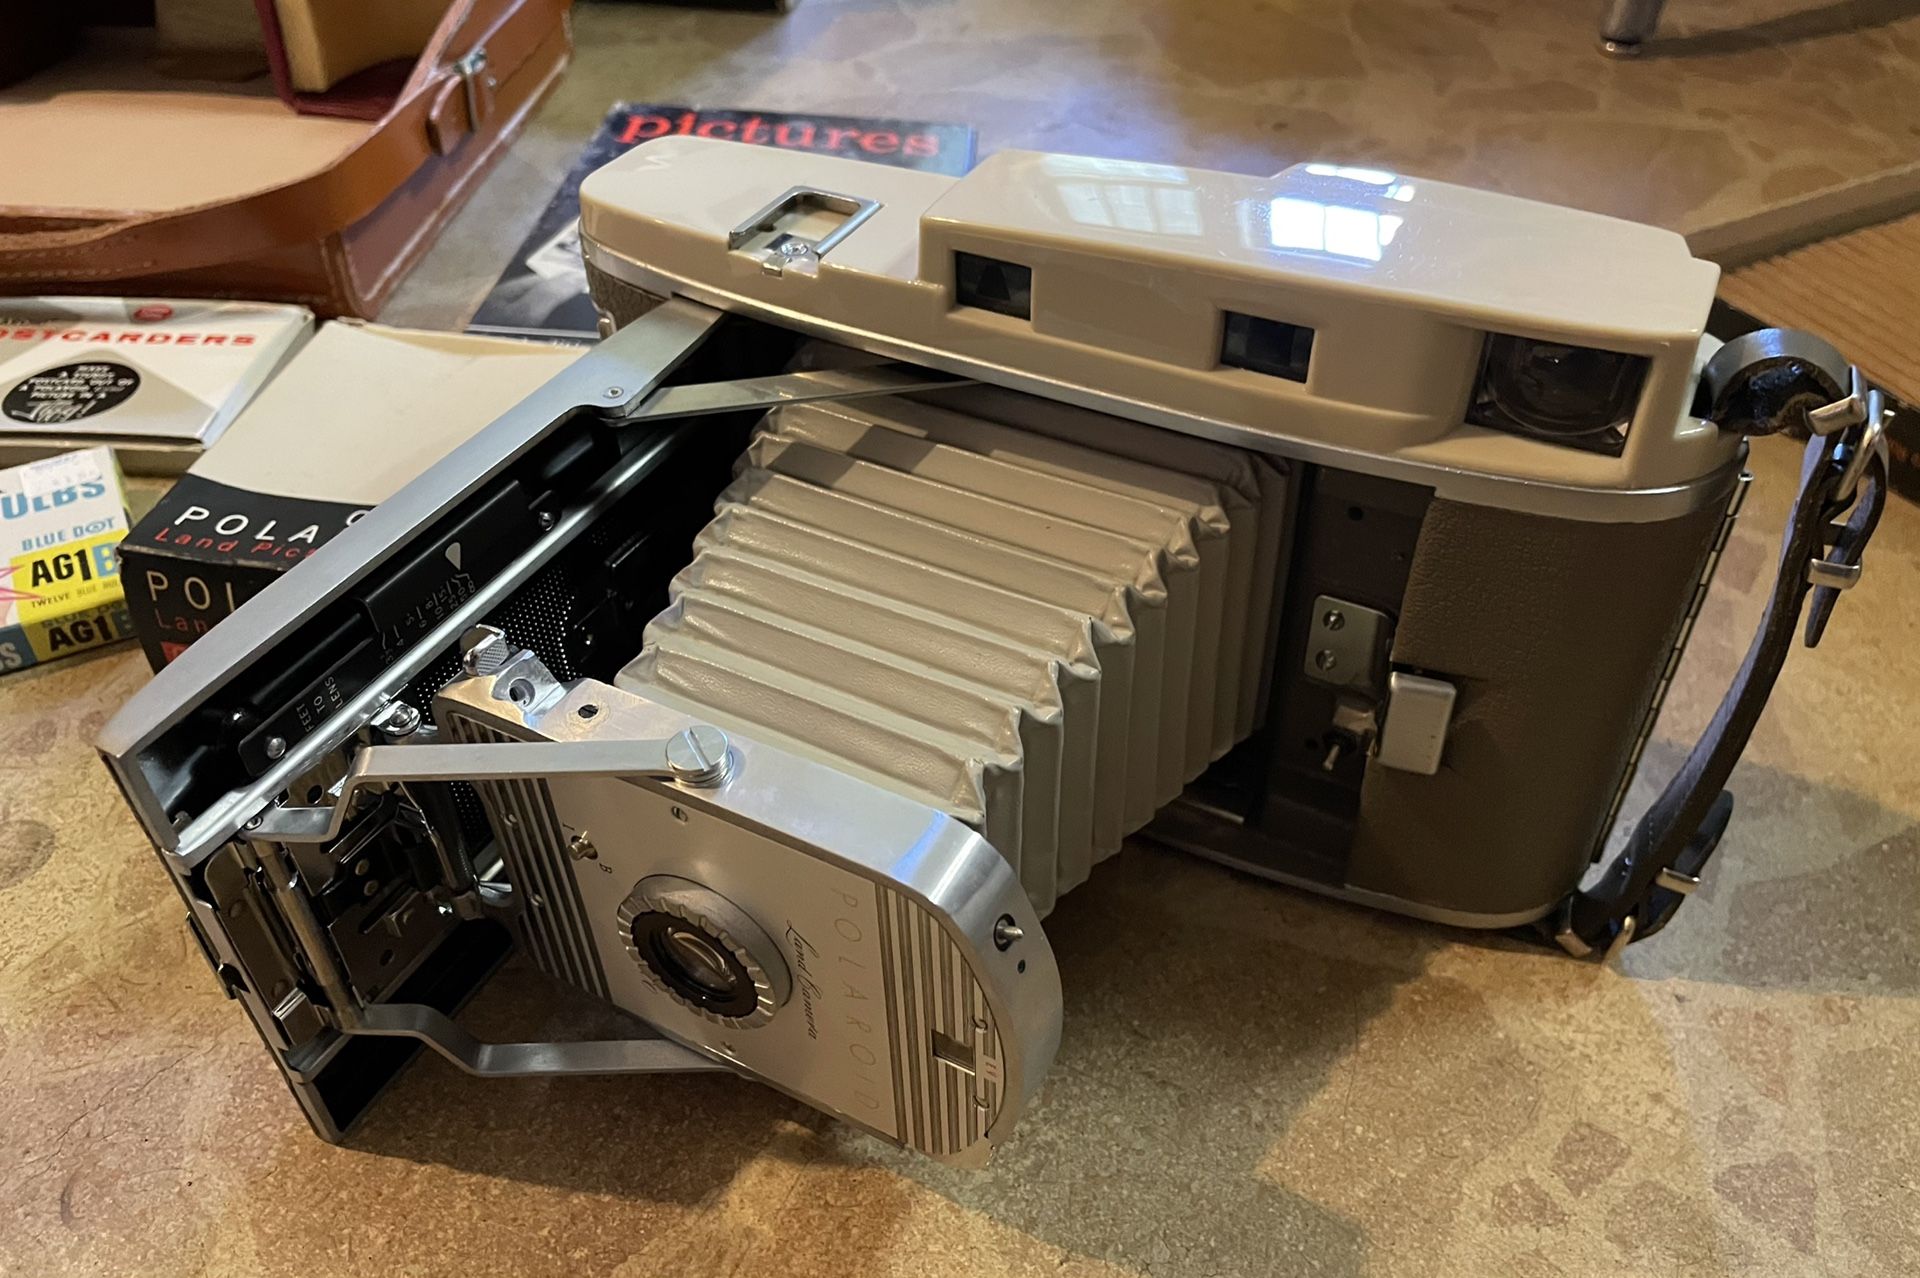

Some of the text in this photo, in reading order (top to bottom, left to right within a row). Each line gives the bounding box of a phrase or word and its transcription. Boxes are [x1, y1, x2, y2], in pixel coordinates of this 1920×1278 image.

[614, 111, 940, 157] pictures
[21, 518, 115, 551] BLUE DOT
[155, 528, 240, 552] Land
[831, 886, 881, 1111] POLAROID
